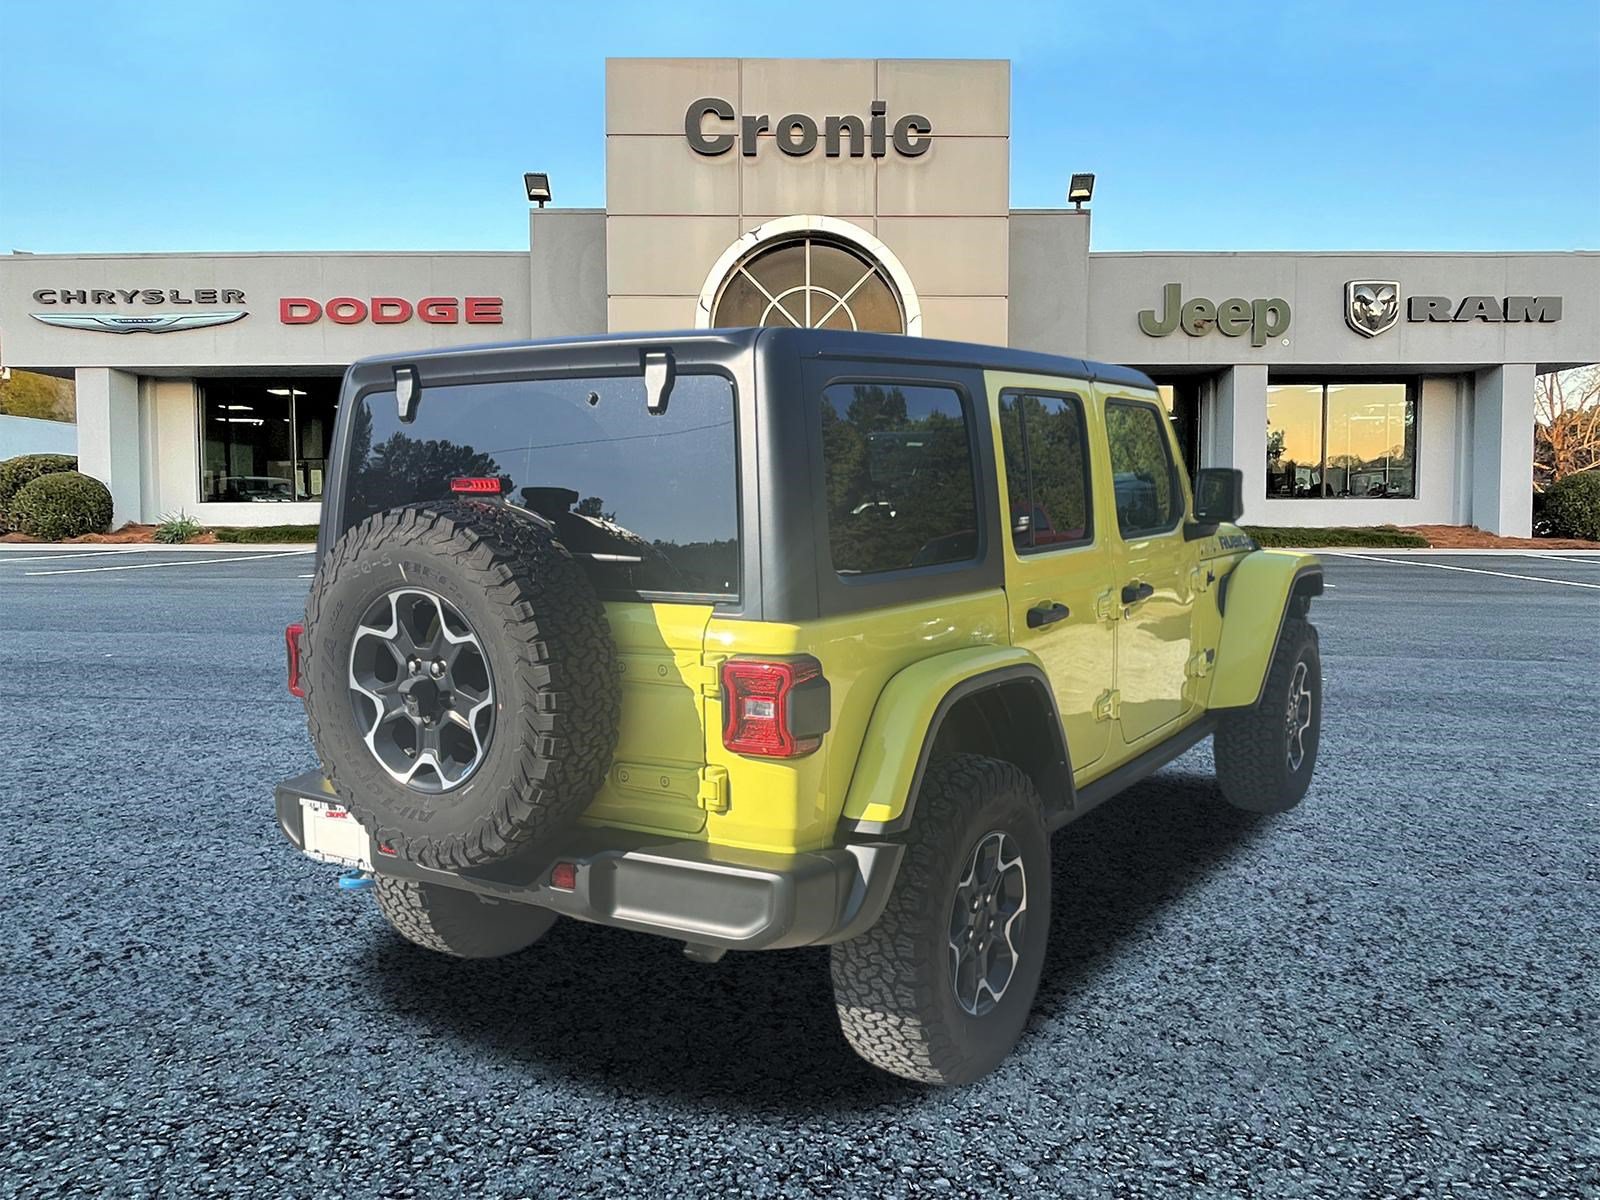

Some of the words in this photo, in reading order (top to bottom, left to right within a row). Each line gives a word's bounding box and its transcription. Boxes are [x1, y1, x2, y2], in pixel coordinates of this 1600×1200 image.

[685, 97, 932, 157] Cronic
[32, 289, 247, 305] CHRYSLER
[279, 297, 504, 324] DODGE
[1407, 296, 1563, 323] RAM
[1138, 283, 1292, 348] Jeep
